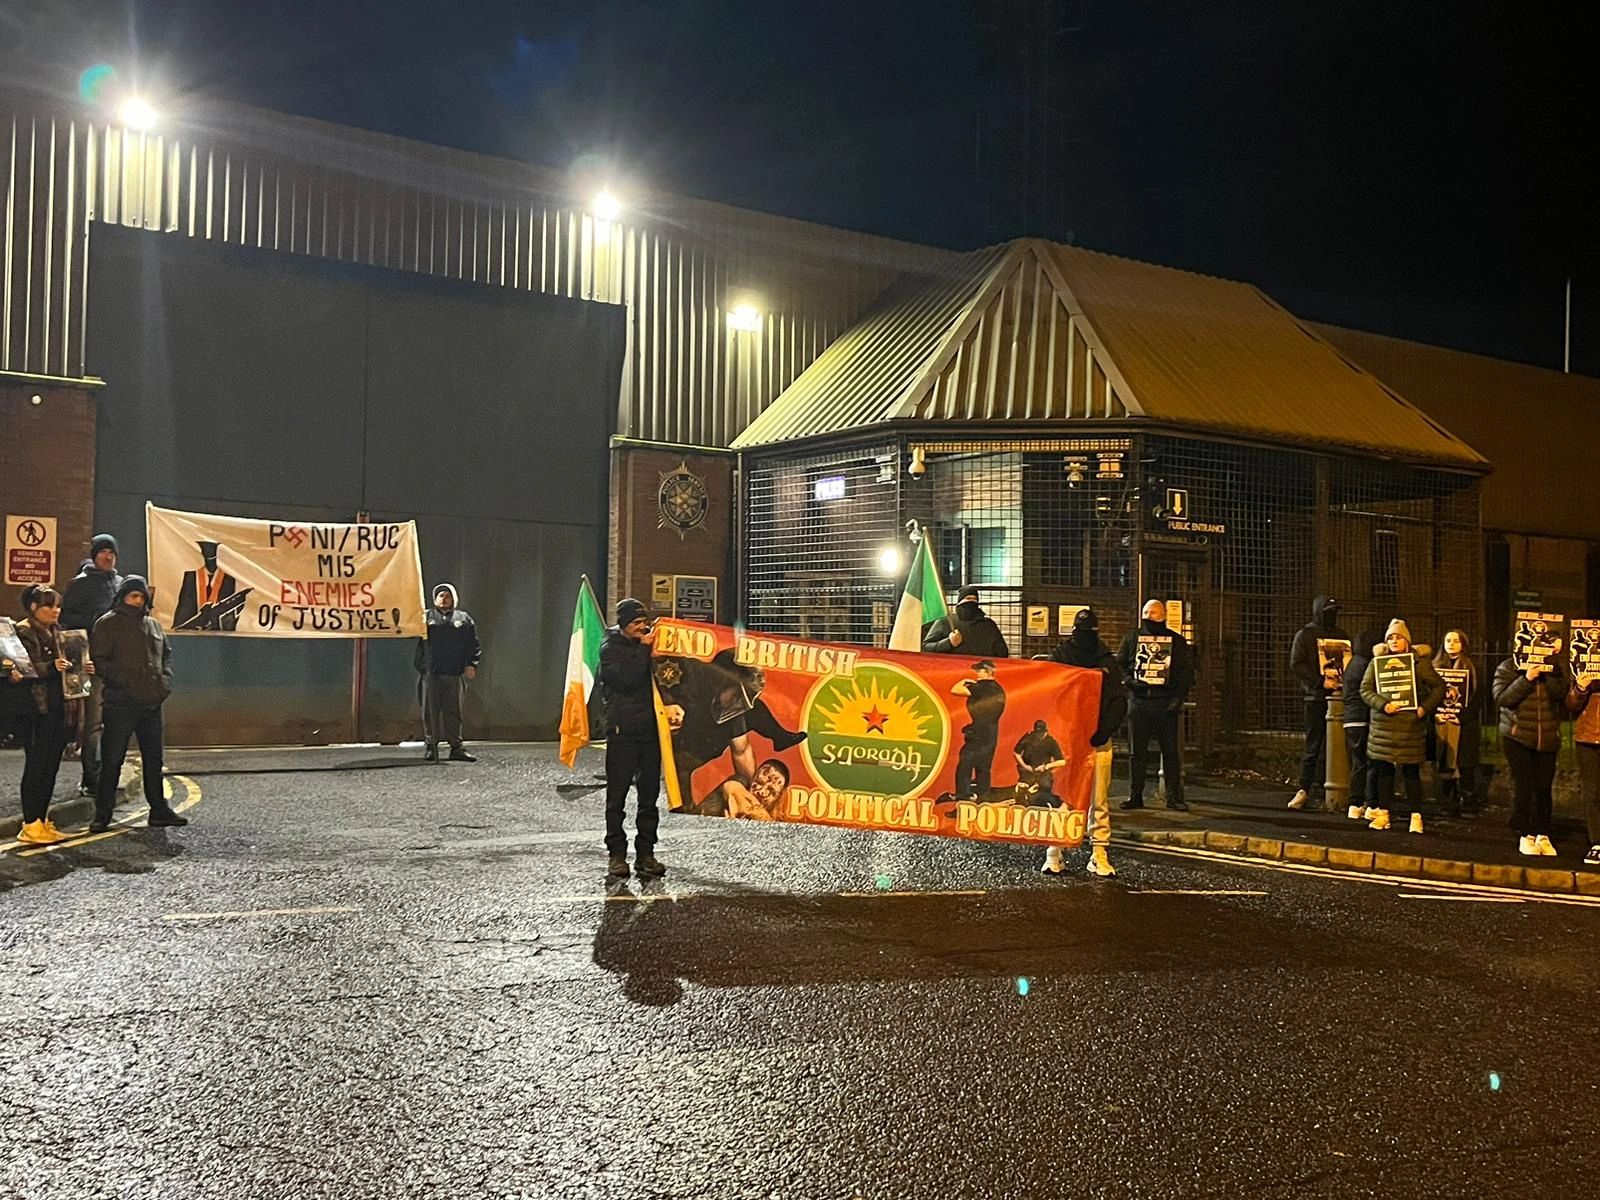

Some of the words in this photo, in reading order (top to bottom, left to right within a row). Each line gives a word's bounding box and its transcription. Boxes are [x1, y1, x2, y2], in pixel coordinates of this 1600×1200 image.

[1168, 521, 1190, 530] PUBLIC
[1191, 522, 1225, 533] ENTRANCE
[281, 580, 375, 608] ENEMIES
[655, 624, 714, 657] END
[736, 636, 857, 677] BRITISH
[789, 788, 936, 828] POLITICAL
[957, 803, 1085, 840] POLICING
